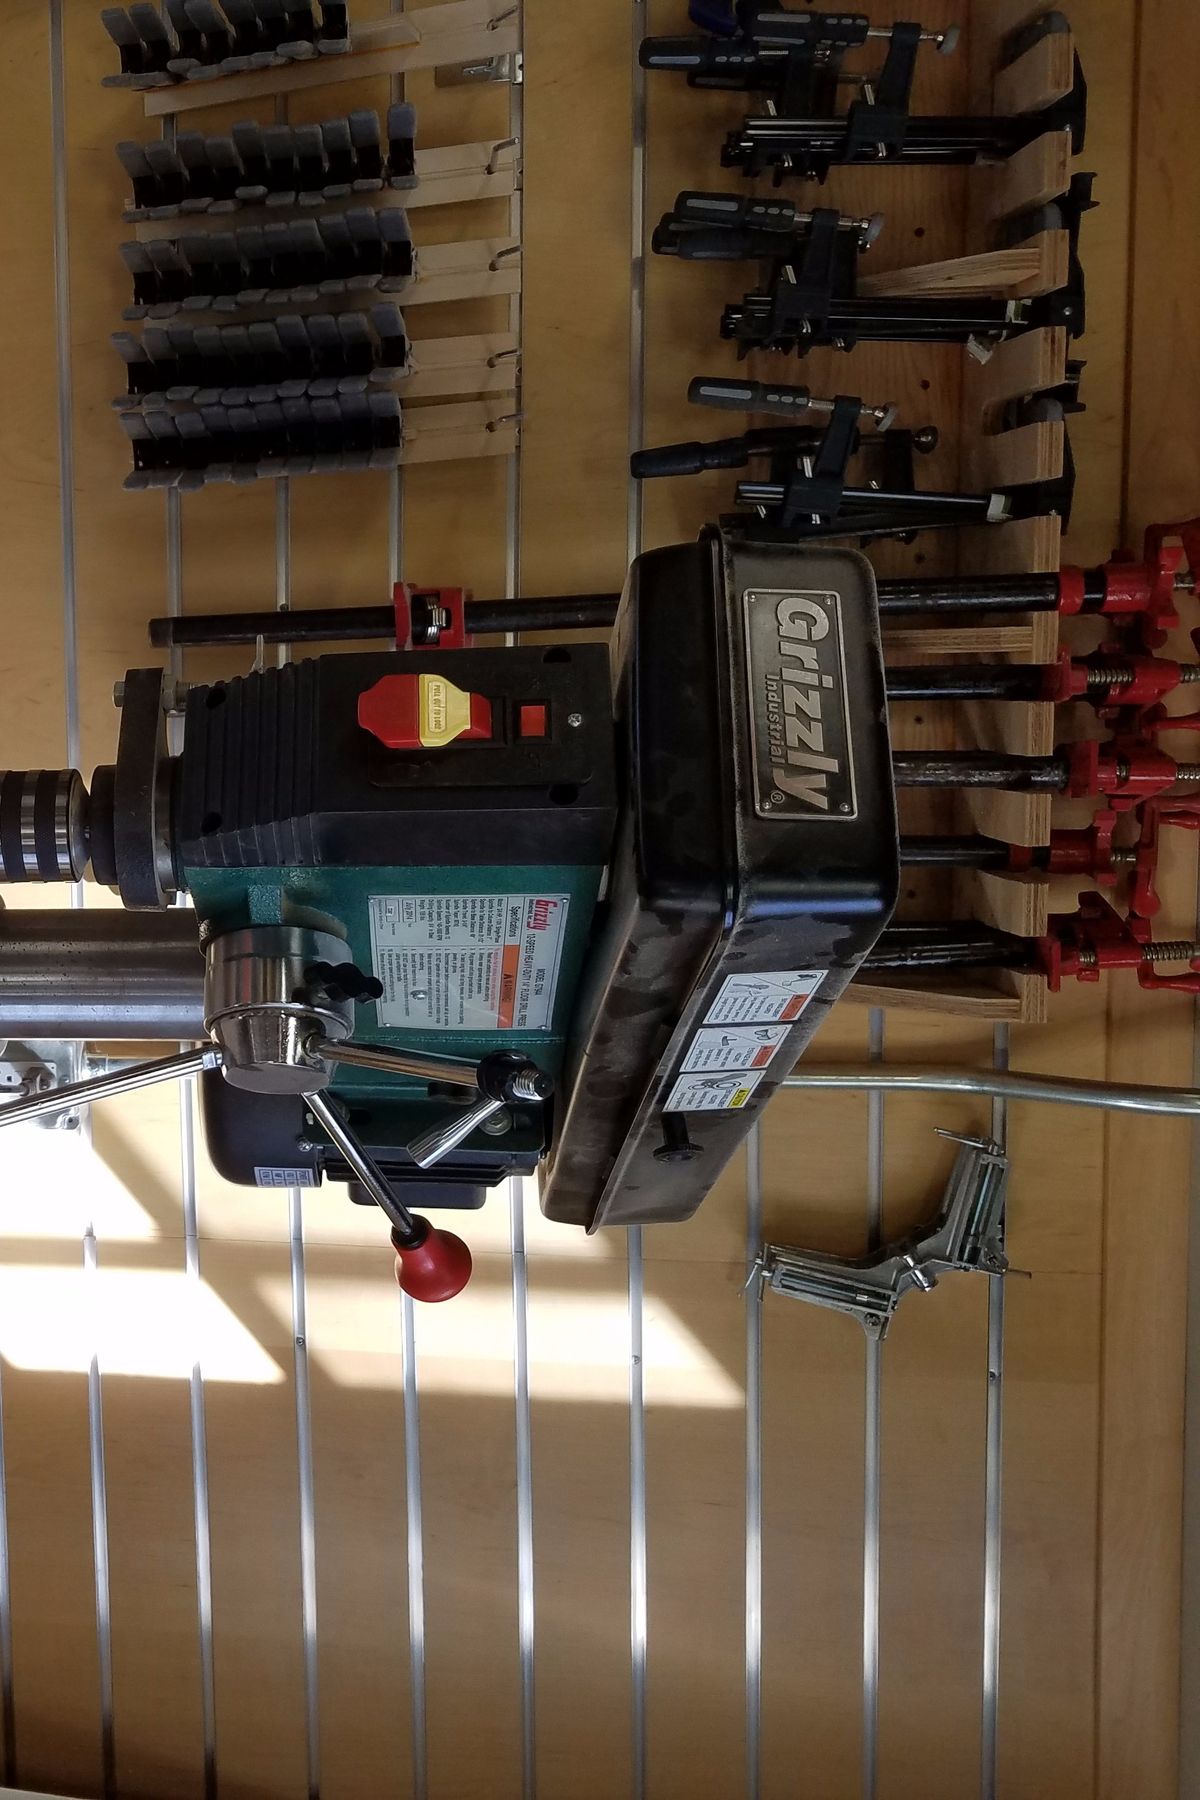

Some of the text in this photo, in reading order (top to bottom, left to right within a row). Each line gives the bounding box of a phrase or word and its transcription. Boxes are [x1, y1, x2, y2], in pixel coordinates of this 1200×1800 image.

[764, 673, 786, 770] Industrial
[773, 597, 839, 810] Grizzly
[509, 905, 521, 938] Specifications
[525, 898, 558, 931] Grizzly
